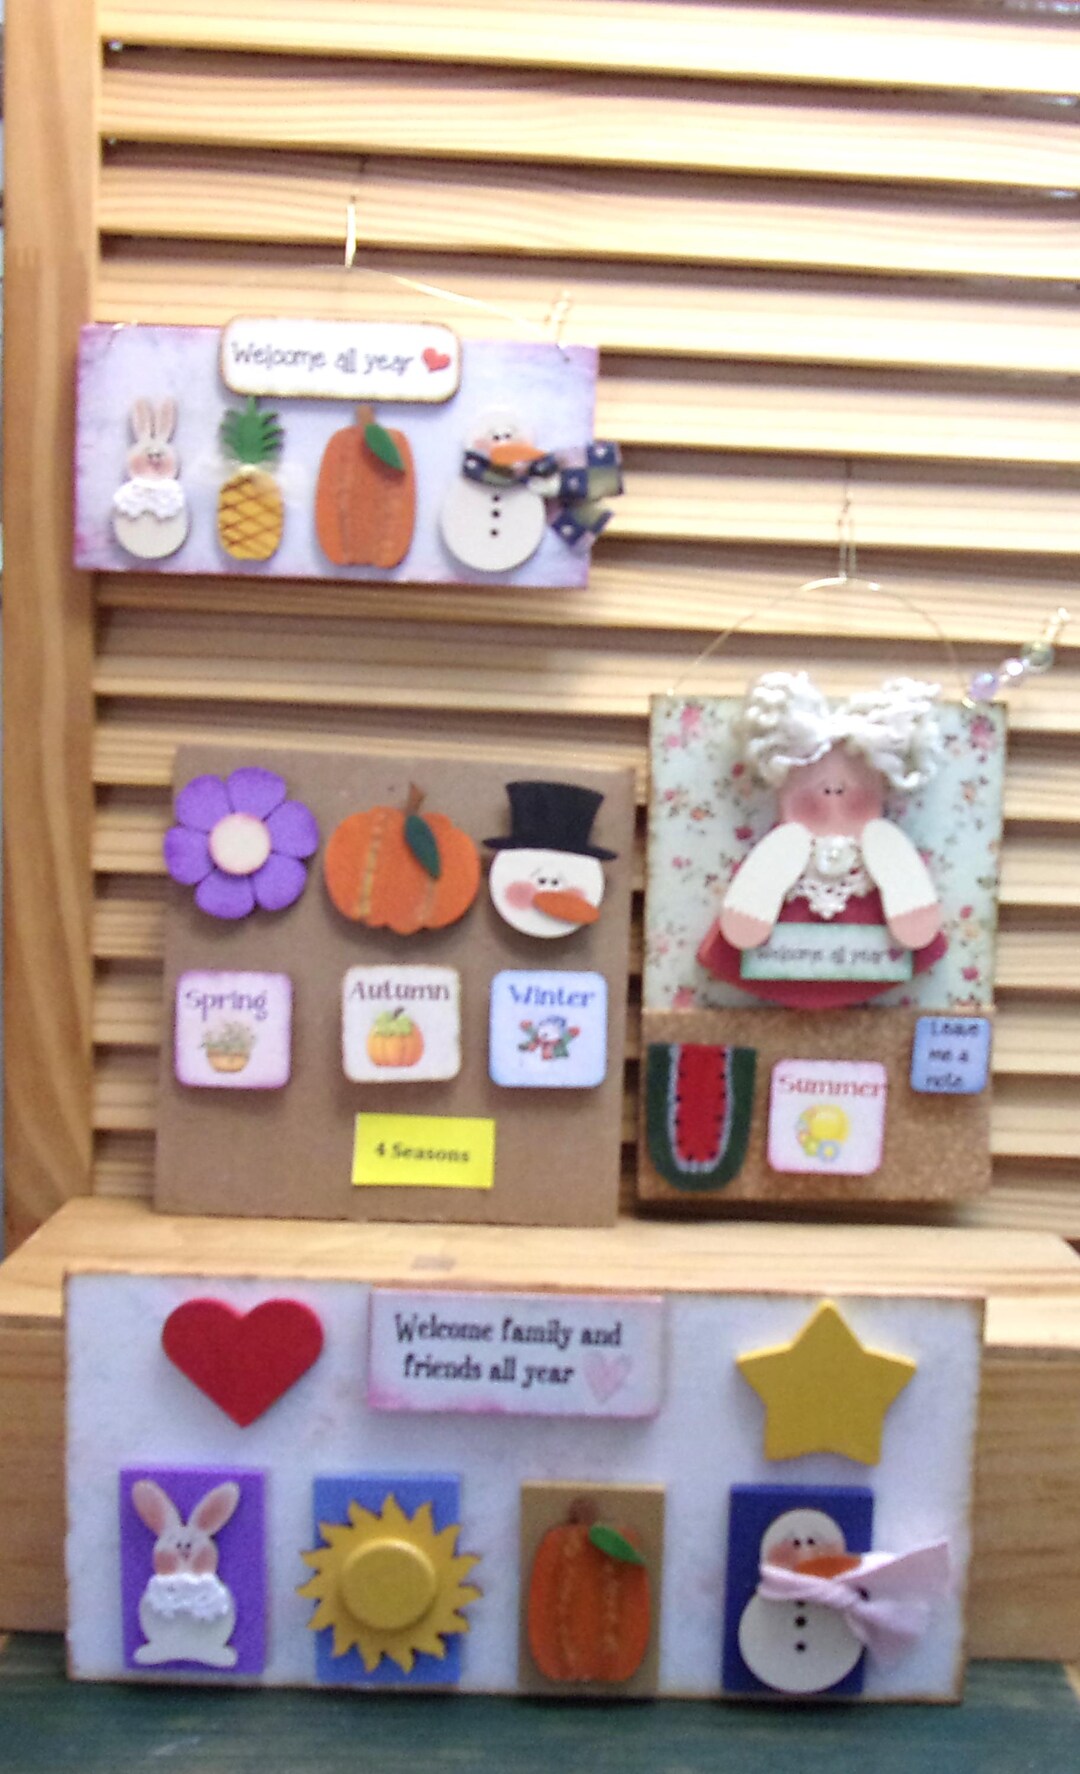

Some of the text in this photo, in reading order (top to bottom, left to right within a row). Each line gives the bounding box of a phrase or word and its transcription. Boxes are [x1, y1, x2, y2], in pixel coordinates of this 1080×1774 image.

[231, 340, 414, 376] Welcome all year
[185, 987, 268, 1022] Spring
[351, 980, 450, 1001] Autumn
[507, 984, 597, 1008] Winter
[778, 1074, 882, 1097] Summer
[375, 1141, 471, 1163] 4 Seasons
[395, 1313, 622, 1352] Welcome family and
[403, 1352, 575, 1389] friends all year
